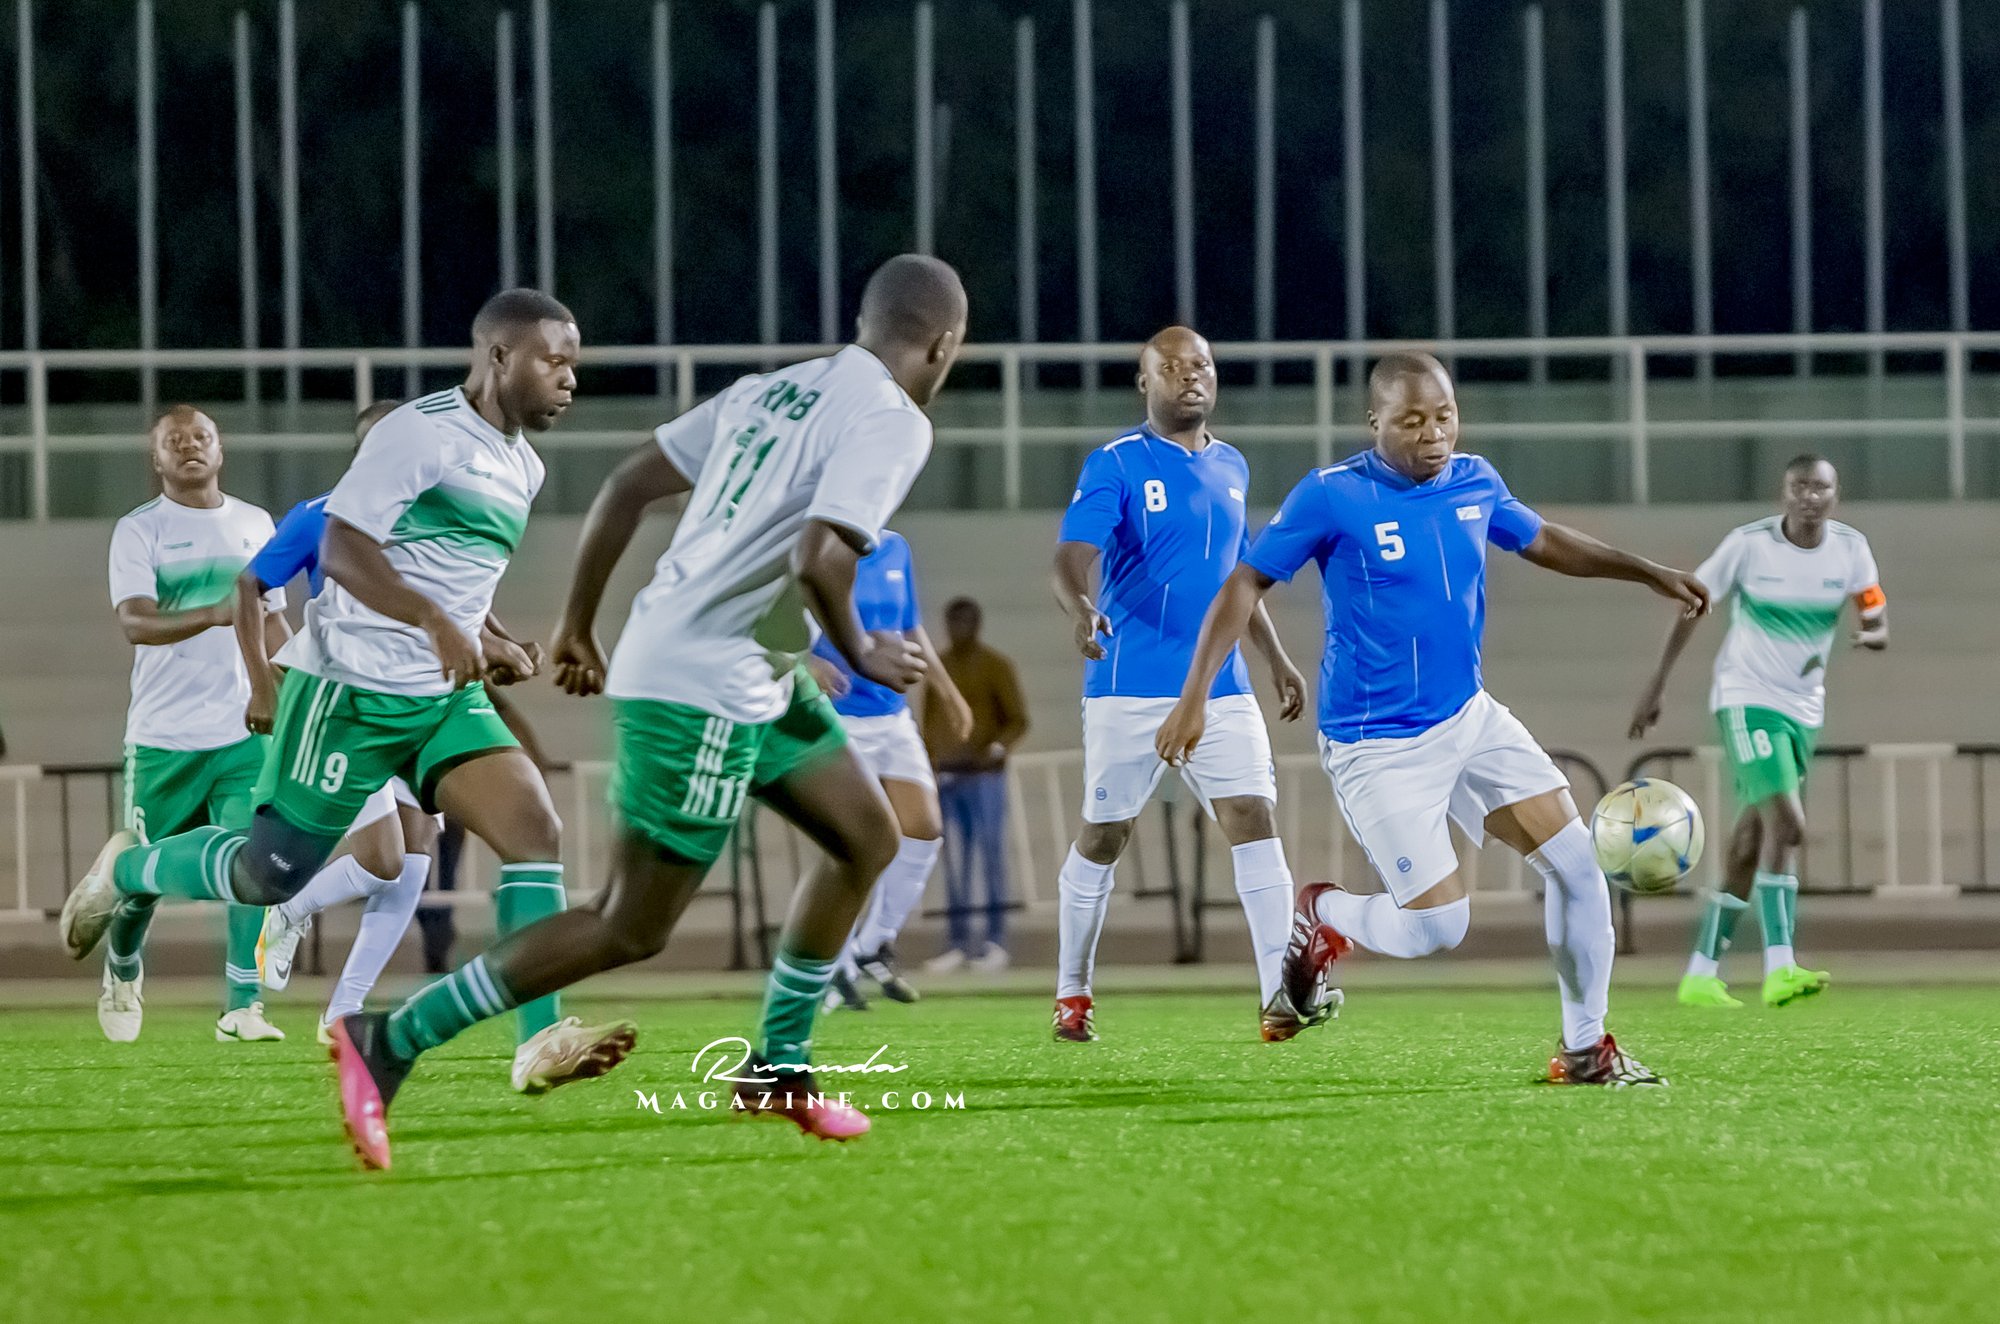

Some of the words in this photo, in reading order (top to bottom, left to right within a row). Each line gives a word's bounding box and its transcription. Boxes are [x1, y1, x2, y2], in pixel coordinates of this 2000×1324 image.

[752, 379, 822, 421] RMB
[1144, 479, 1168, 512] 8
[1374, 521, 1406, 561] 5
[1752, 728, 1773, 758] 8
[320, 751, 349, 793] 9
[132, 805, 150, 847] 6
